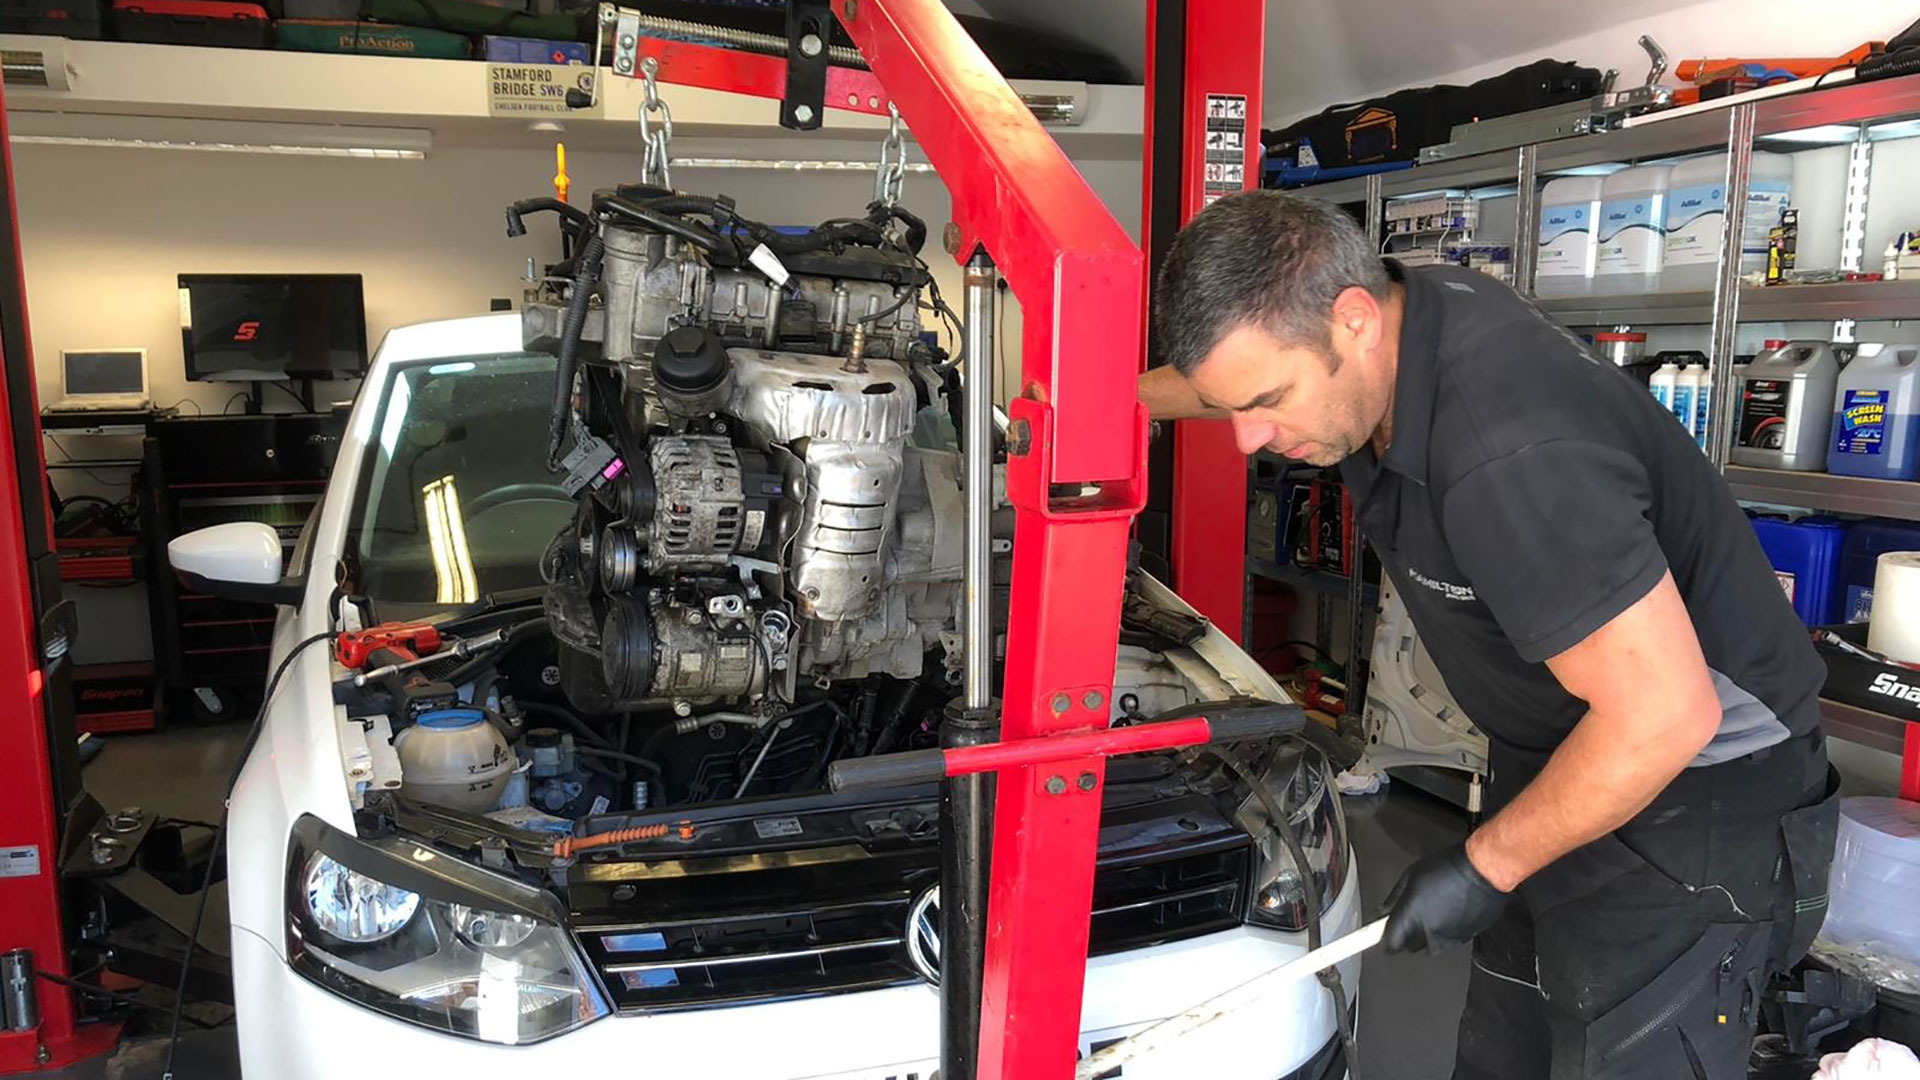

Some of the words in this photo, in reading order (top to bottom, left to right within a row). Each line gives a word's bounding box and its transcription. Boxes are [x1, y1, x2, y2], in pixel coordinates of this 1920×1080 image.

[492, 67, 552, 82] STAMFORD
[493, 82, 536, 96] BRIDGE
[540, 84, 564, 97] SW6
[494, 102, 522, 110] CHELSEA
[1846, 404, 1884, 419] SCREEN
[1854, 414, 1882, 425] WASH
[1868, 672, 1920, 708] Sna
